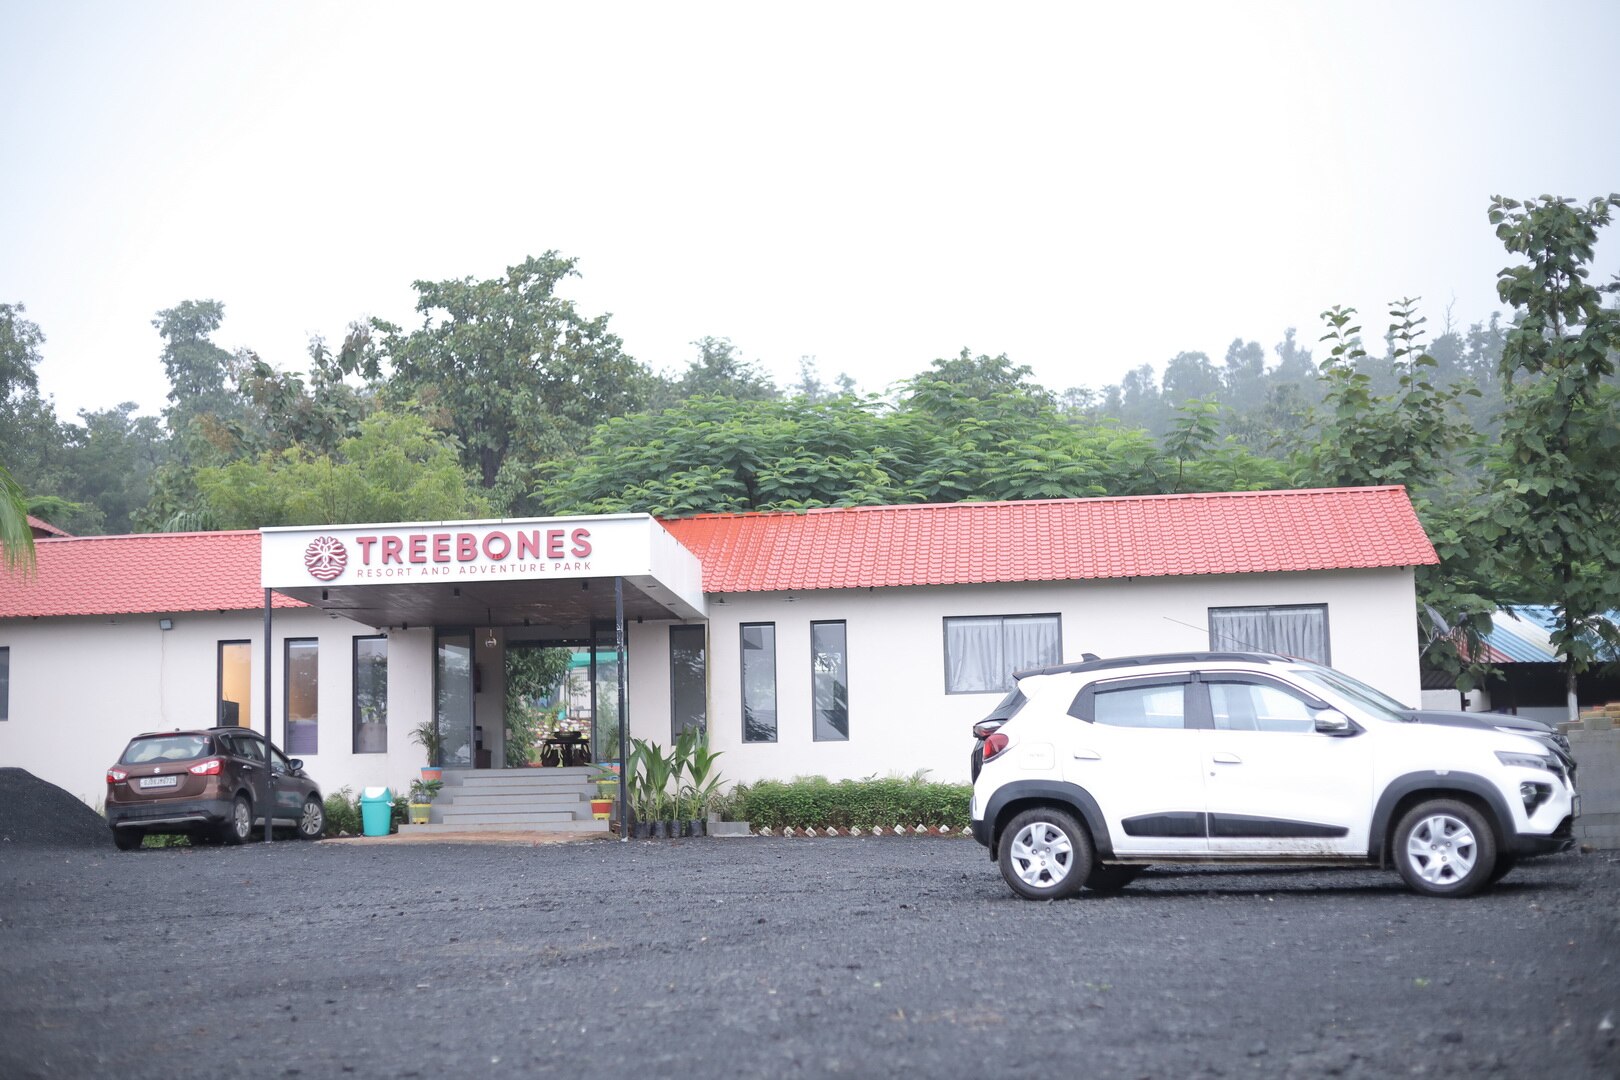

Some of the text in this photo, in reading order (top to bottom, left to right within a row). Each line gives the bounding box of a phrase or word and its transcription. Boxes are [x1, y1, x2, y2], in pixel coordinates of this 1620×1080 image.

[356, 528, 592, 565] TREEBONES
[357, 561, 591, 578] RESORT AND ADVENTURE PARK
